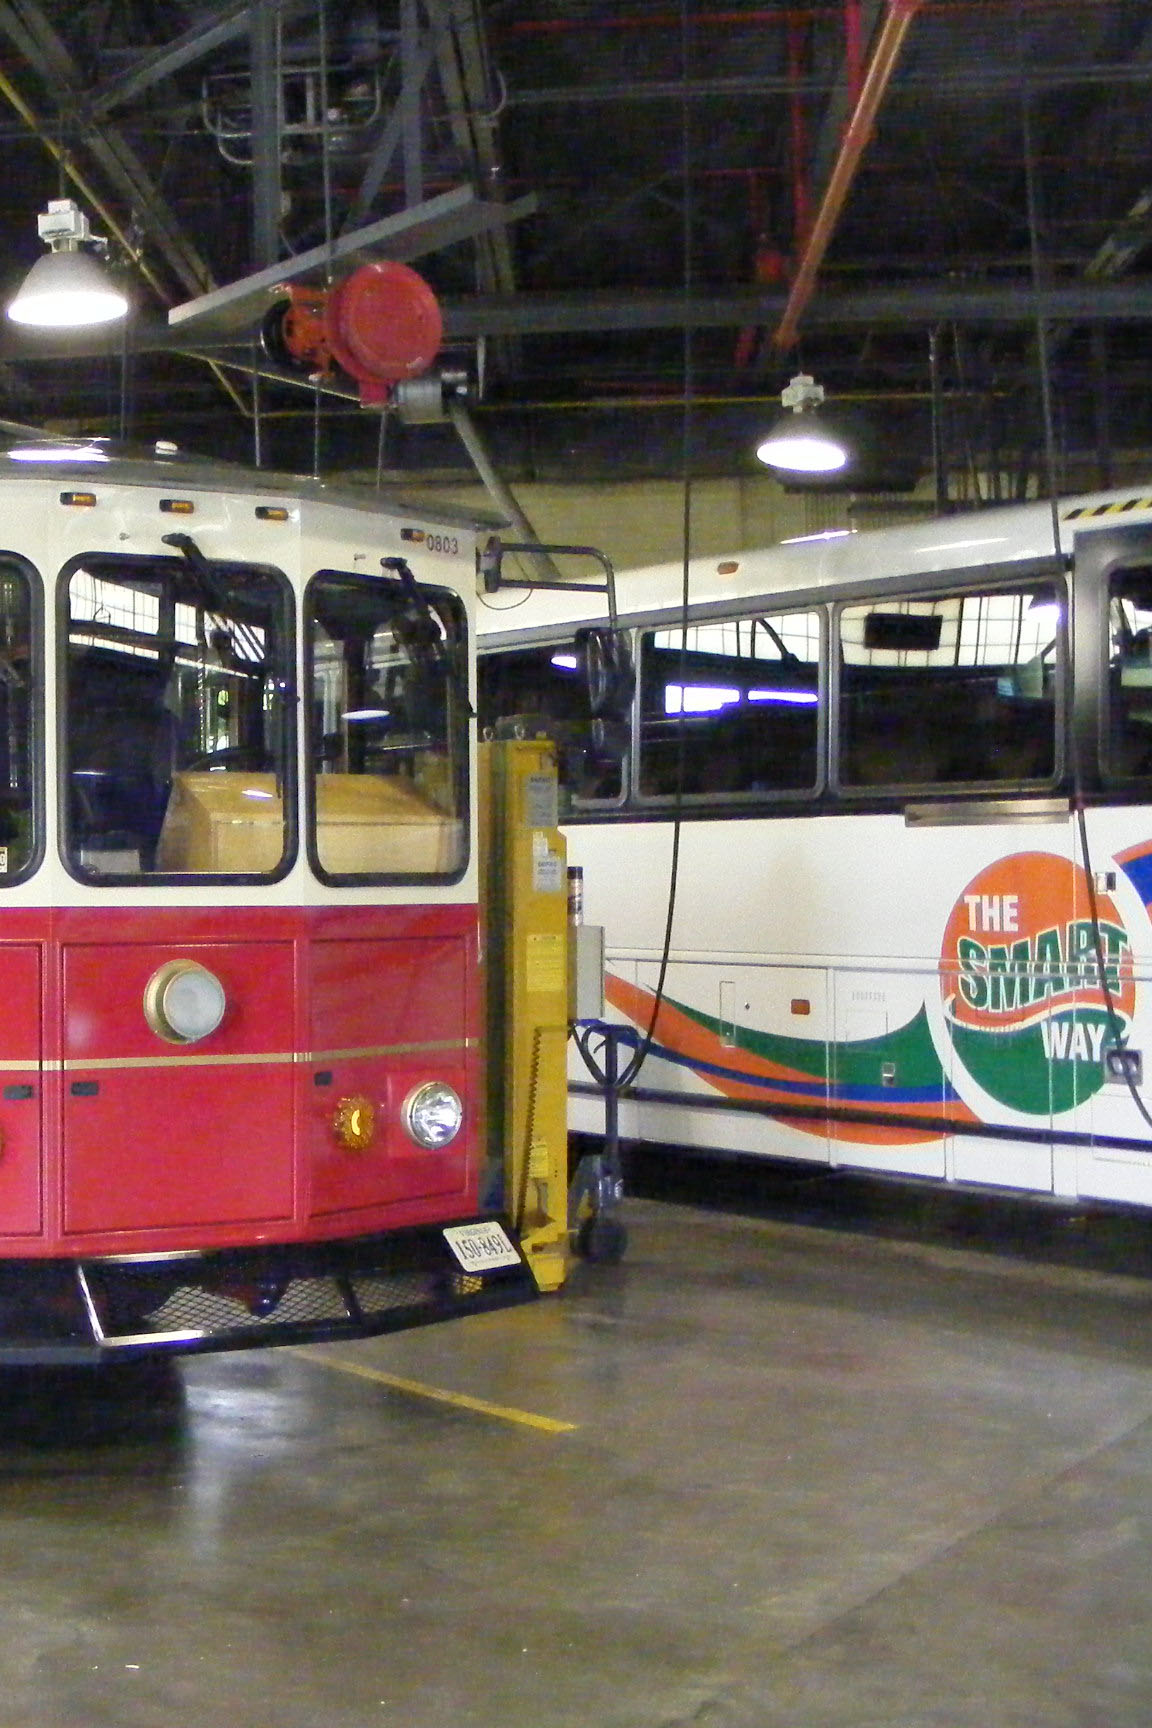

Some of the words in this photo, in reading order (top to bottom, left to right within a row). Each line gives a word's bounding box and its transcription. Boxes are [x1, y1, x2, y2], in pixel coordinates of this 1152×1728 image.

[427, 535, 458, 555] 0803
[964, 895, 1019, 932] THE
[957, 919, 1129, 1012] SMART
[1041, 1022, 1106, 1062] WAY
